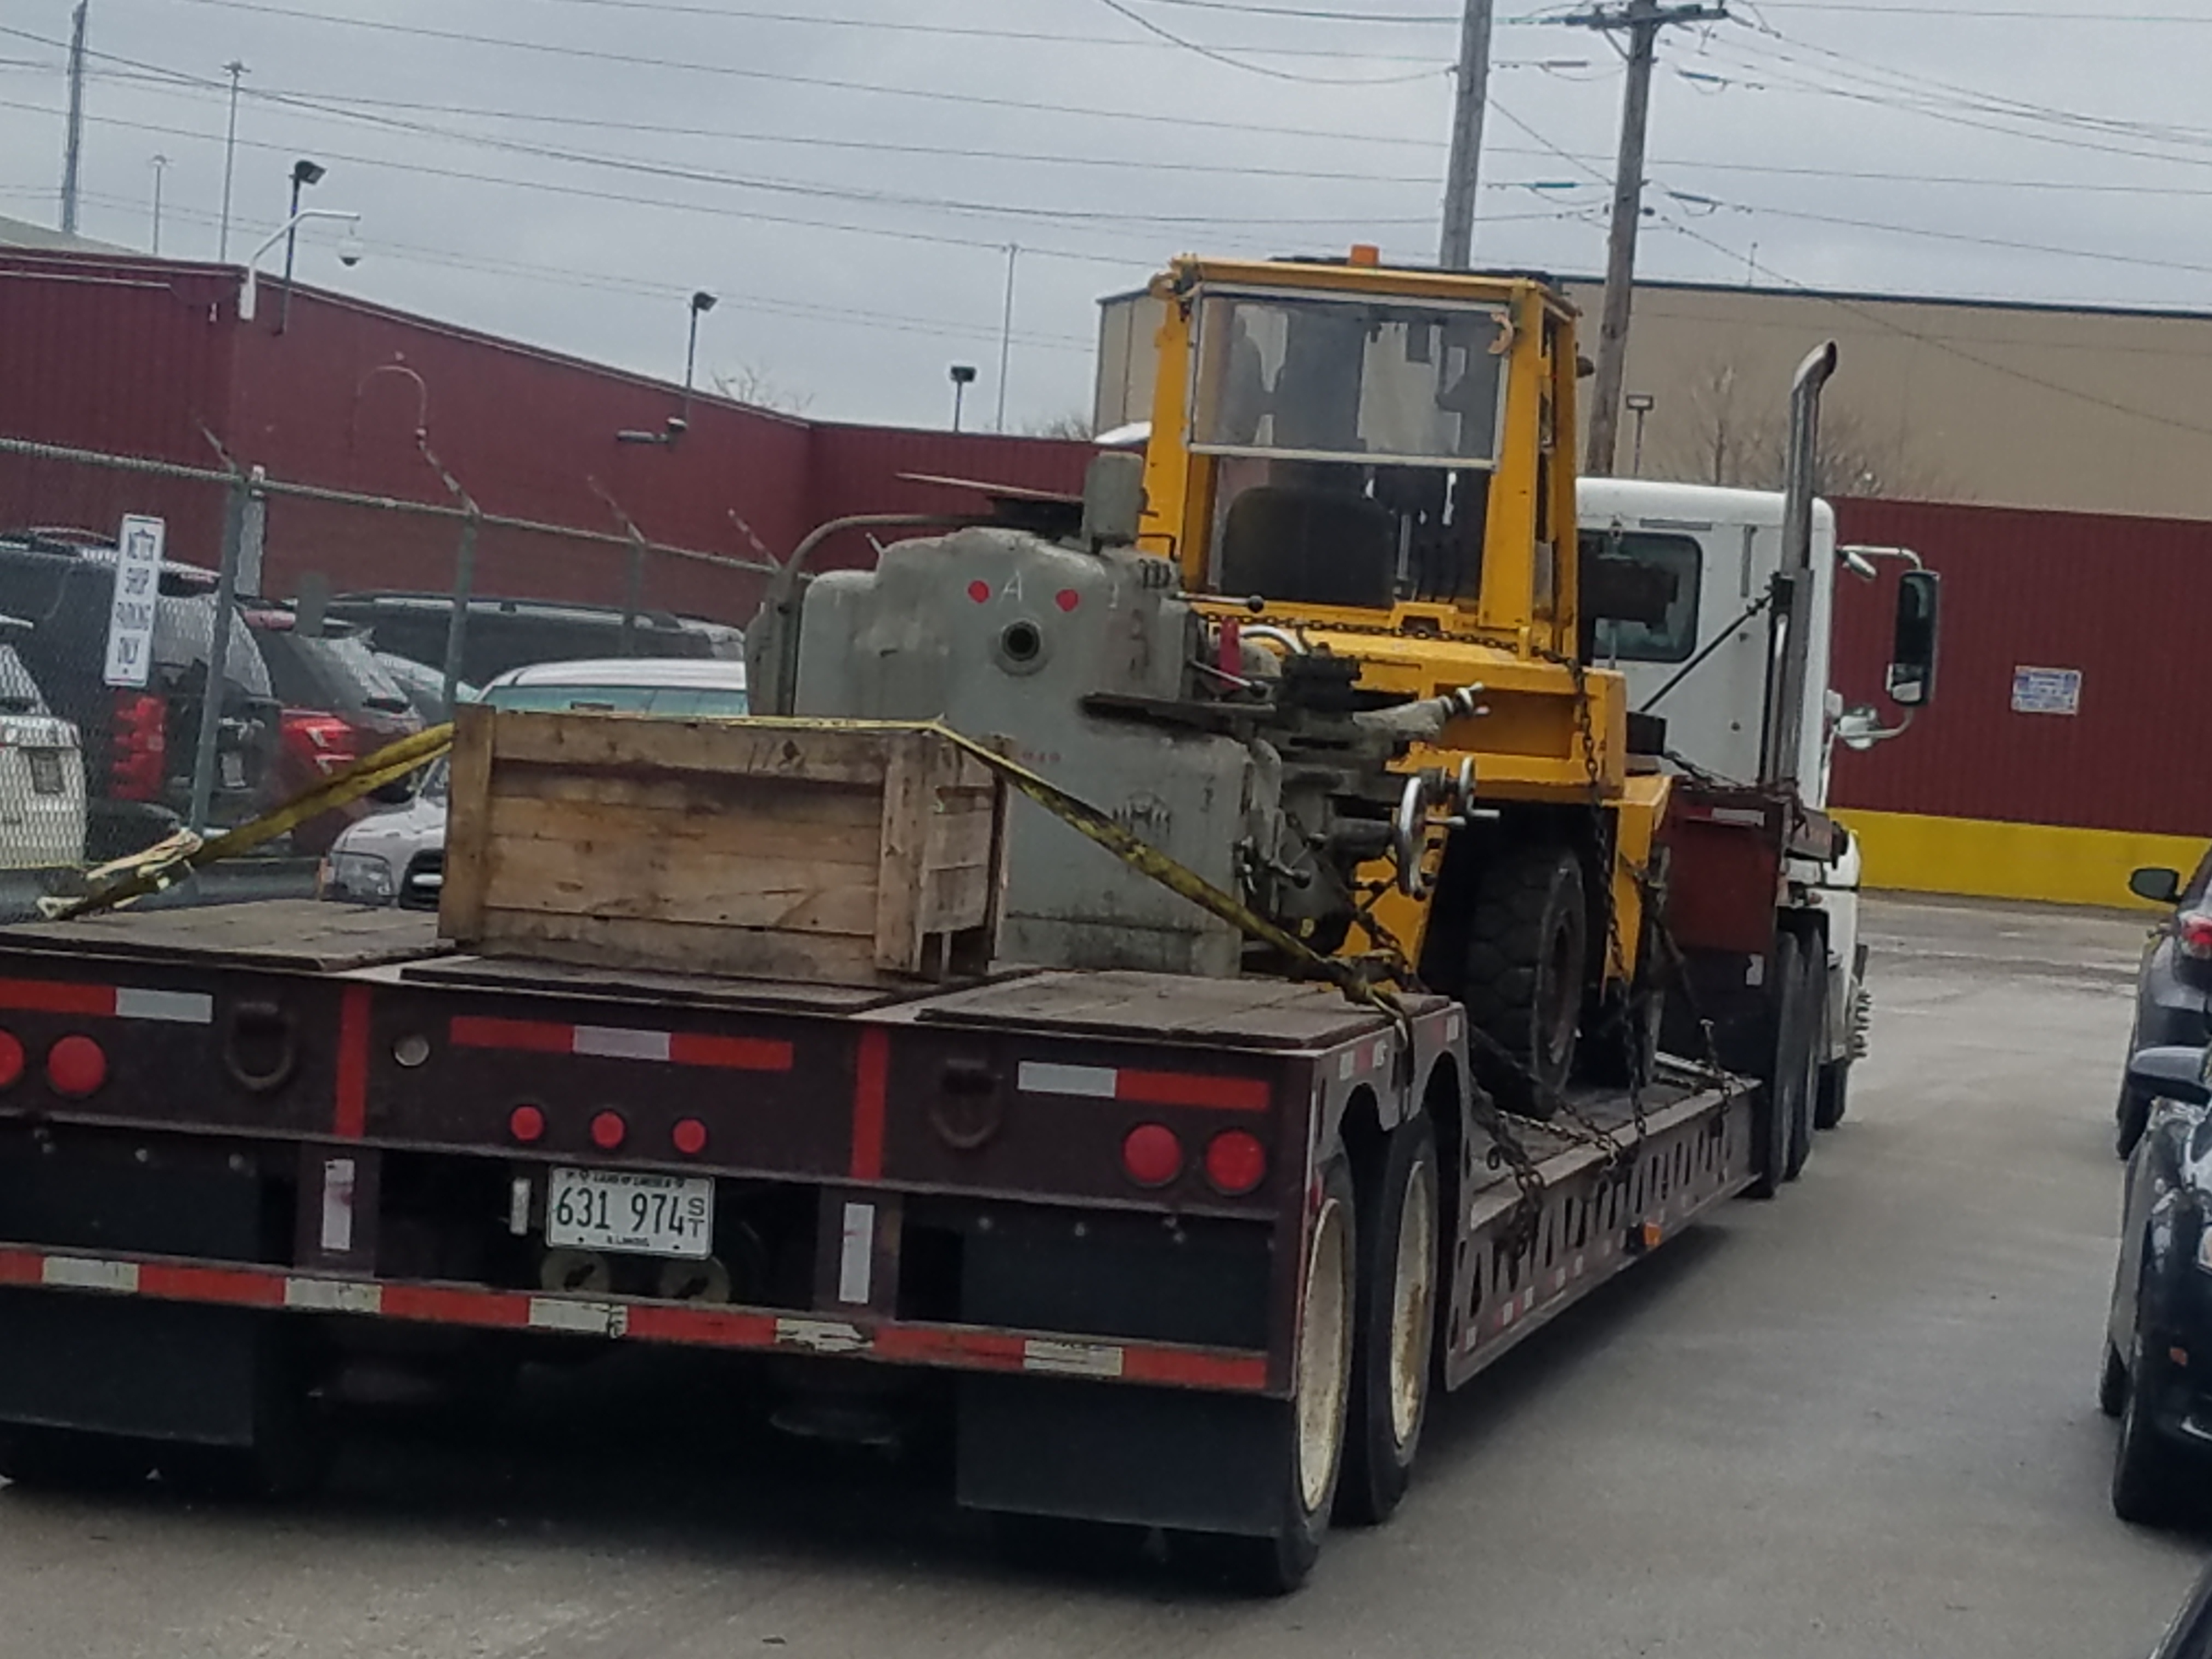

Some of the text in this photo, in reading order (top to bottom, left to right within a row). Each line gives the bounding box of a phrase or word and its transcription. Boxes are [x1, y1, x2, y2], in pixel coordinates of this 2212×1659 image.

[998, 569, 1022, 605] A
[556, 1187, 685, 1236] 631 974
